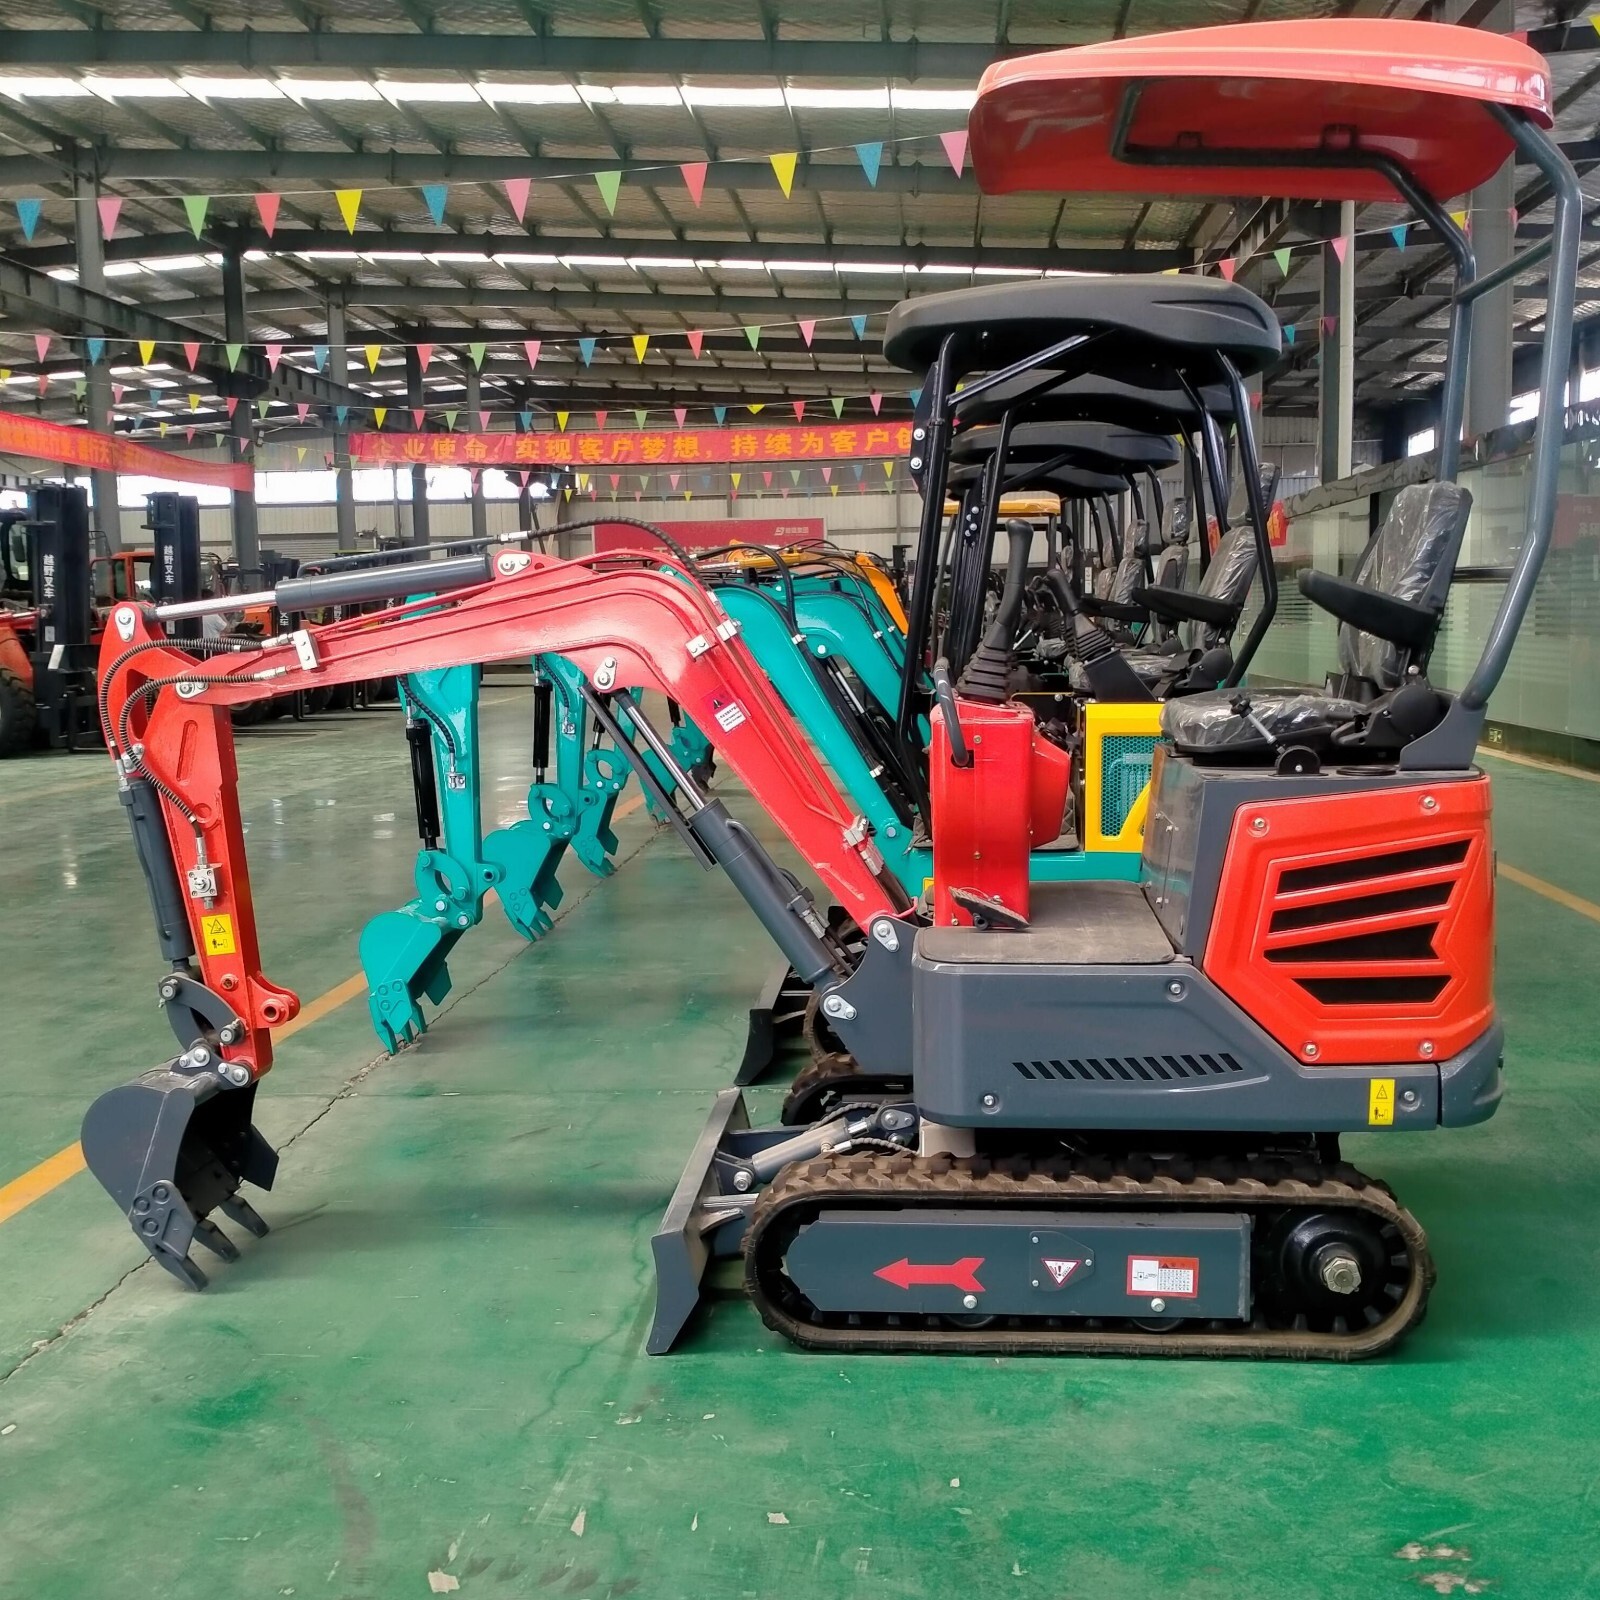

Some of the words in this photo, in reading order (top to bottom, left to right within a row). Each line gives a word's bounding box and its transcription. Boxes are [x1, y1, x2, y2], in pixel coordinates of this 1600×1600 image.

[43, 554, 55, 598] 越野叉车
[163, 544, 175, 585] 越野叉车
[280, 611, 289, 626] 叉车
